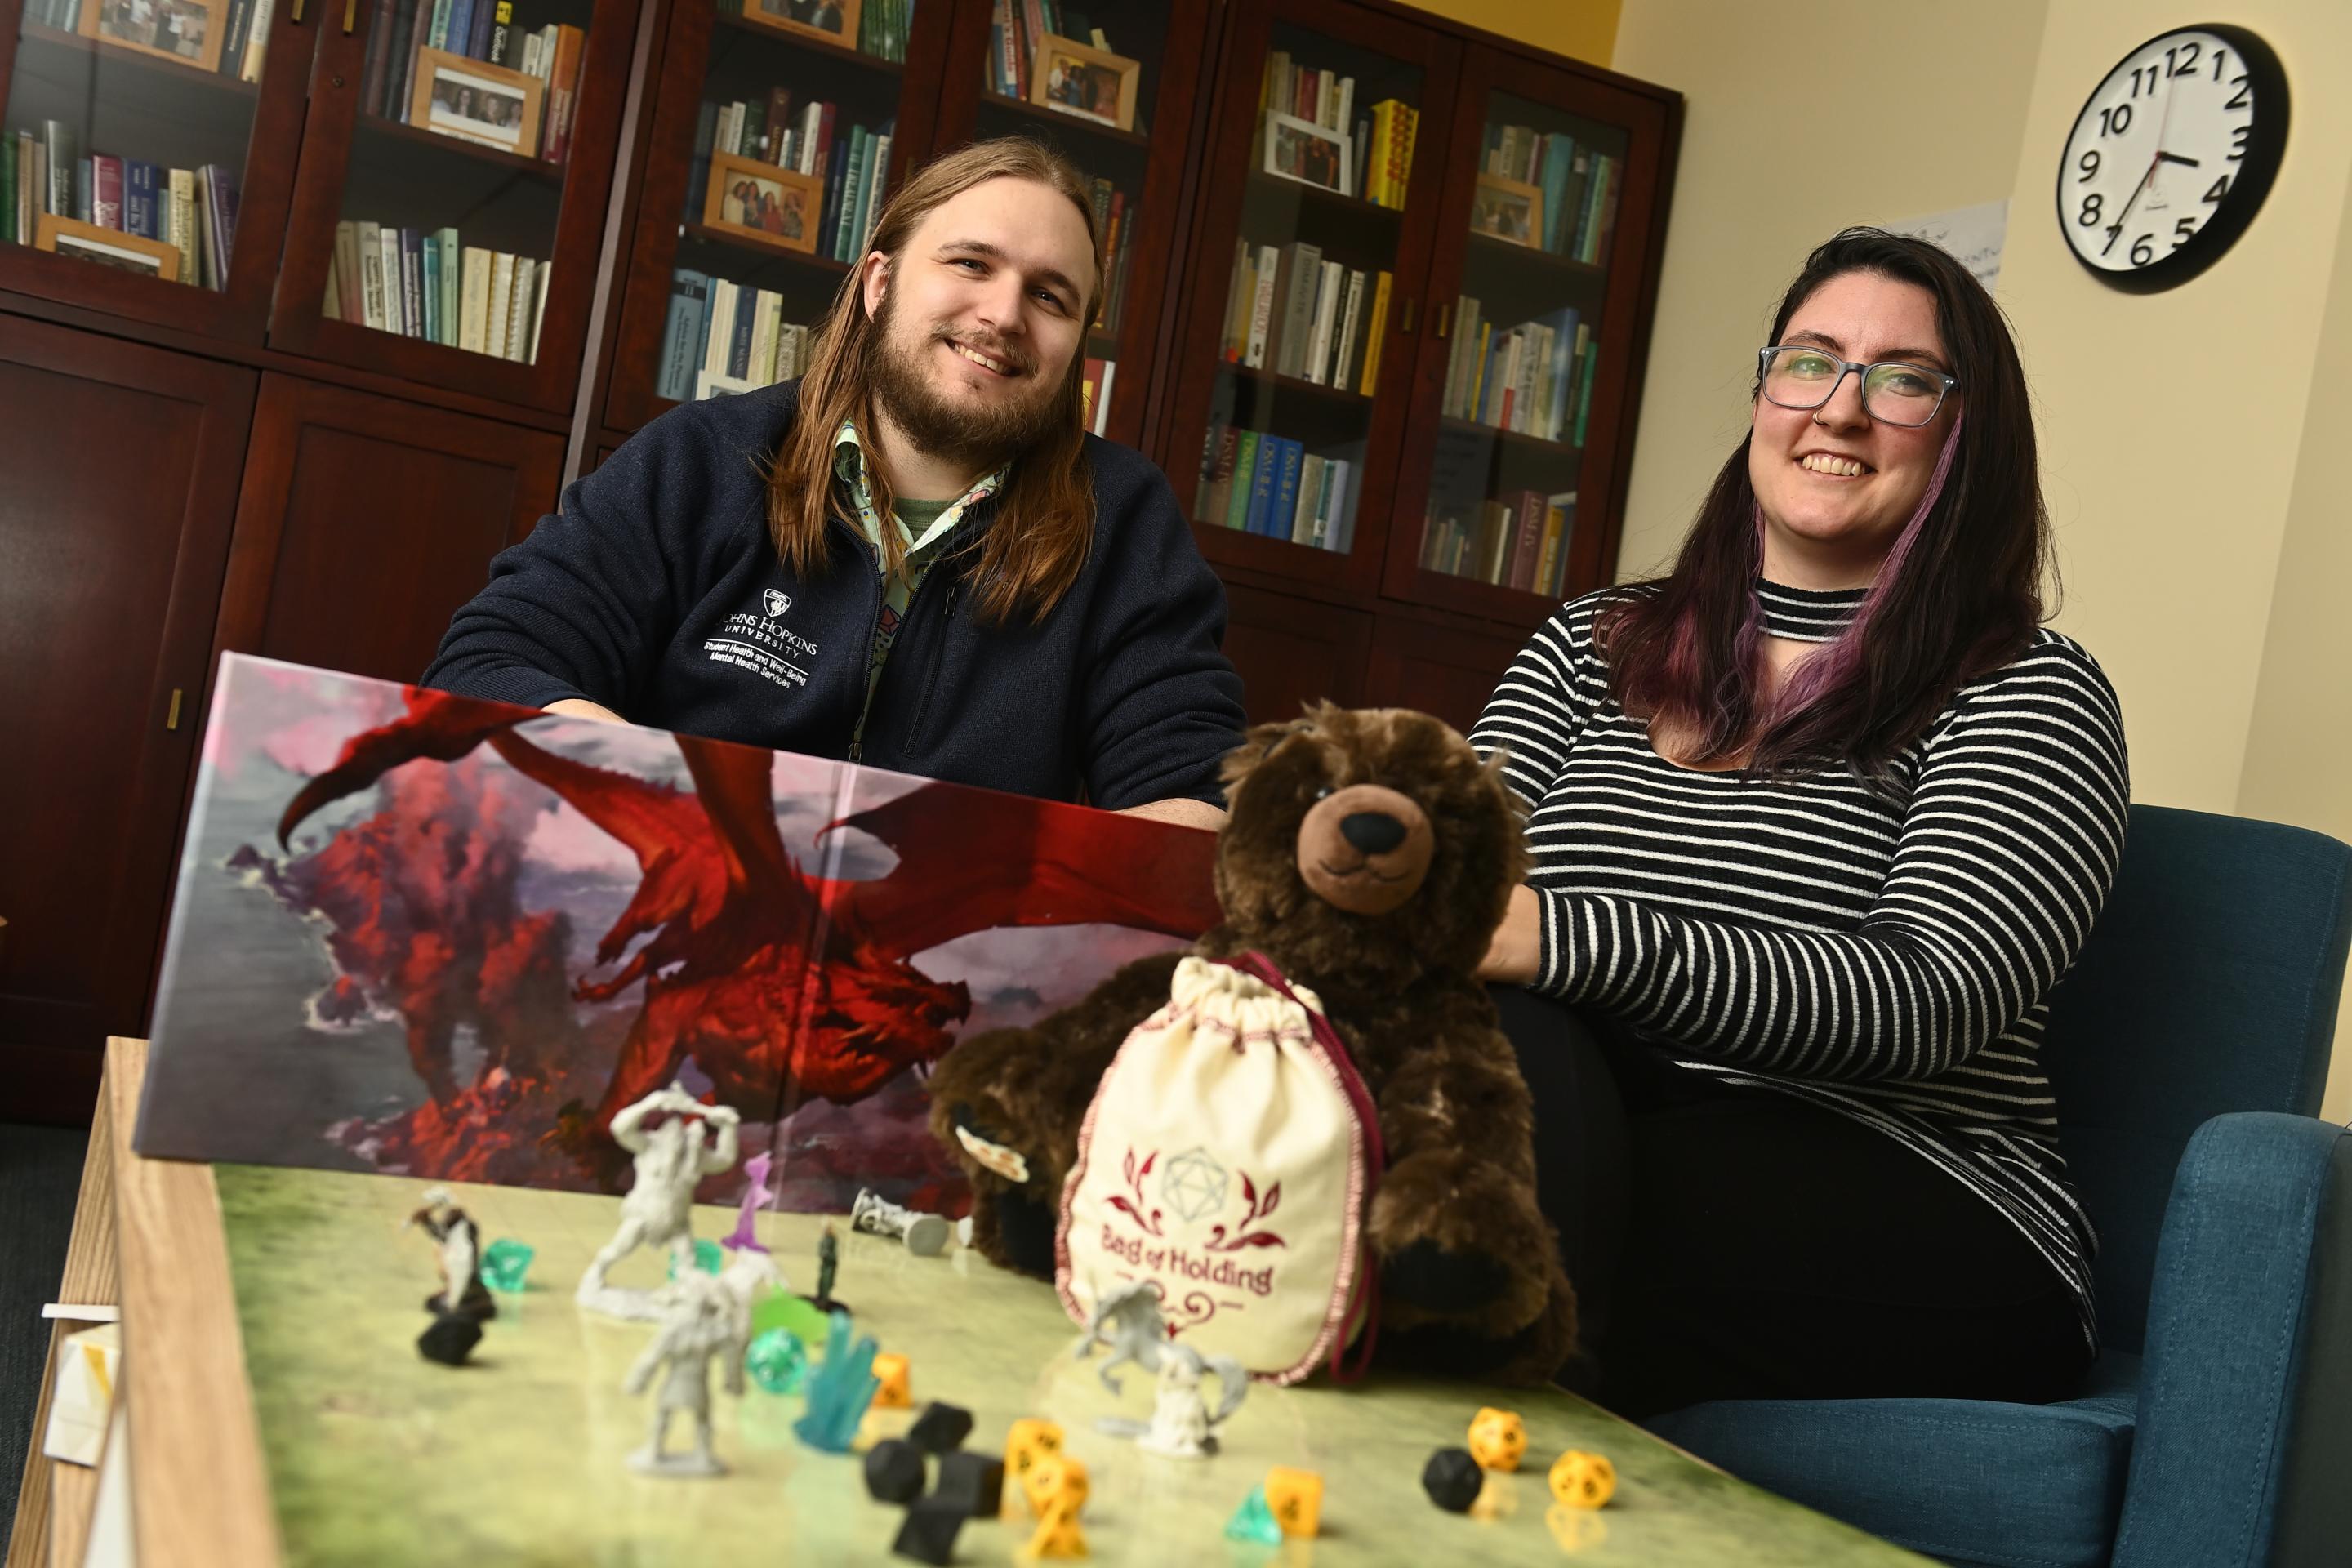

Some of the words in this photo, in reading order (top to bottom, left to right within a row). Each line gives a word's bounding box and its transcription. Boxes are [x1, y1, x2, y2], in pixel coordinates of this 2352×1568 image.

[2165, 42, 2201, 78] 12
[2212, 50, 2226, 81] 1
[2131, 65, 2159, 98] 11
[2224, 74, 2250, 110] 2
[2100, 104, 2132, 137] 10
[2226, 126, 2252, 161] 3
[2078, 150, 2100, 183] 9
[2202, 175, 2230, 203] 4
[2078, 193, 2103, 227] 8
[2102, 224, 2123, 256] 7
[2172, 216, 2197, 248] 5
[2131, 233, 2154, 266] 6
[721, 613, 759, 626] OHNS
[759, 617, 818, 656] HOPKINS
[724, 625, 800, 659] UNIVERSITY
[703, 641, 730, 653] Student
[730, 644, 754, 660] Health
[755, 653, 769, 666] and
[768, 658, 807, 687] Well-Being
[710, 651, 735, 663] Mental
[734, 655, 760, 674] Health
[760, 666, 791, 688] Services
[1101, 1223, 1143, 1266] Bag
[1146, 1247, 1165, 1272] of
[1169, 1248, 1274, 1297] Holding
